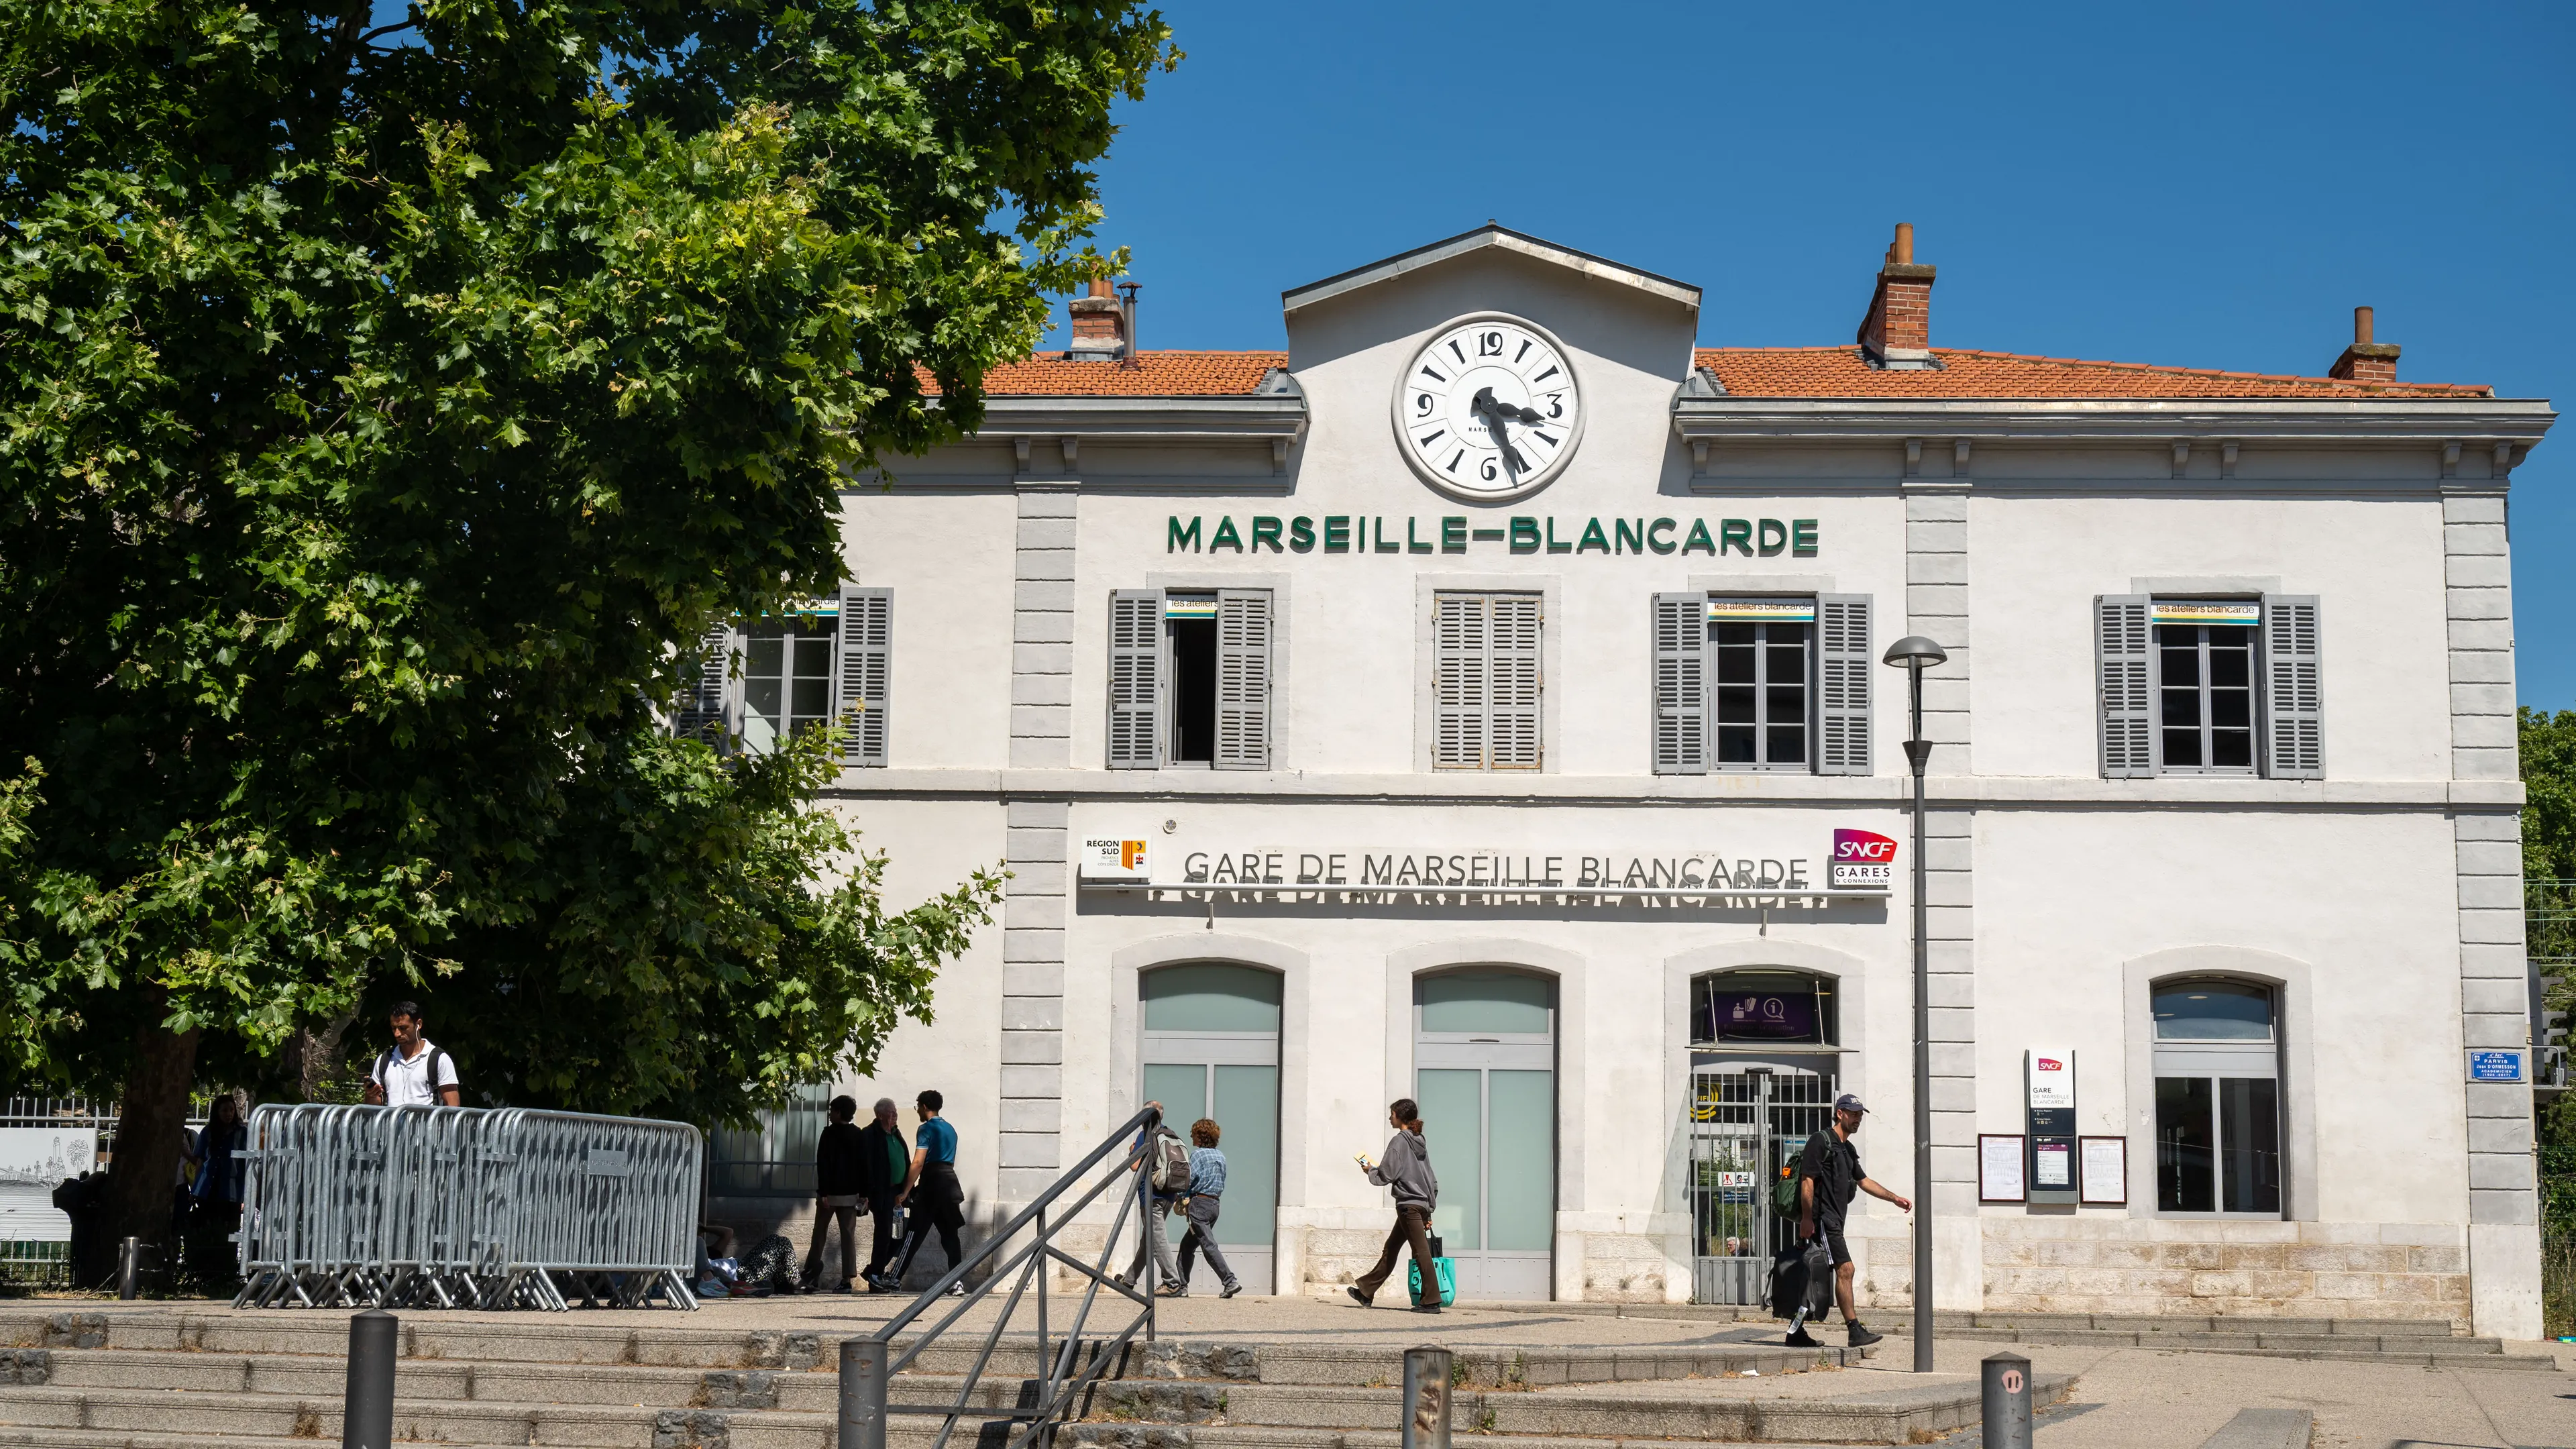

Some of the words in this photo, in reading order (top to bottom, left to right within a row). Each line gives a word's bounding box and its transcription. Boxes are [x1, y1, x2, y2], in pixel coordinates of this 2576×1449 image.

[1478, 331, 1503, 356] 12
[1417, 393, 1434, 418] 9
[1546, 393, 1562, 418] 3
[1481, 456, 1497, 481] 6
[1171, 598, 1185, 607] les
[1714, 601, 1728, 610] les
[1729, 601, 1763, 610] ateliers
[1765, 602, 1811, 611] blancarde
[2156, 603, 2170, 612] les
[2171, 603, 2205, 613] ateliers
[2207, 604, 2255, 614] blancarde
[1087, 839, 1120, 847] RÉGION
[1837, 841, 1893, 858] SNCF
[1184, 852, 1283, 881] GARE
[1300, 853, 1346, 881] DE
[1364, 854, 1563, 885] MARSEILLE
[1580, 856, 1809, 885] BLANCARDE
[1835, 867, 1890, 877] GARES
